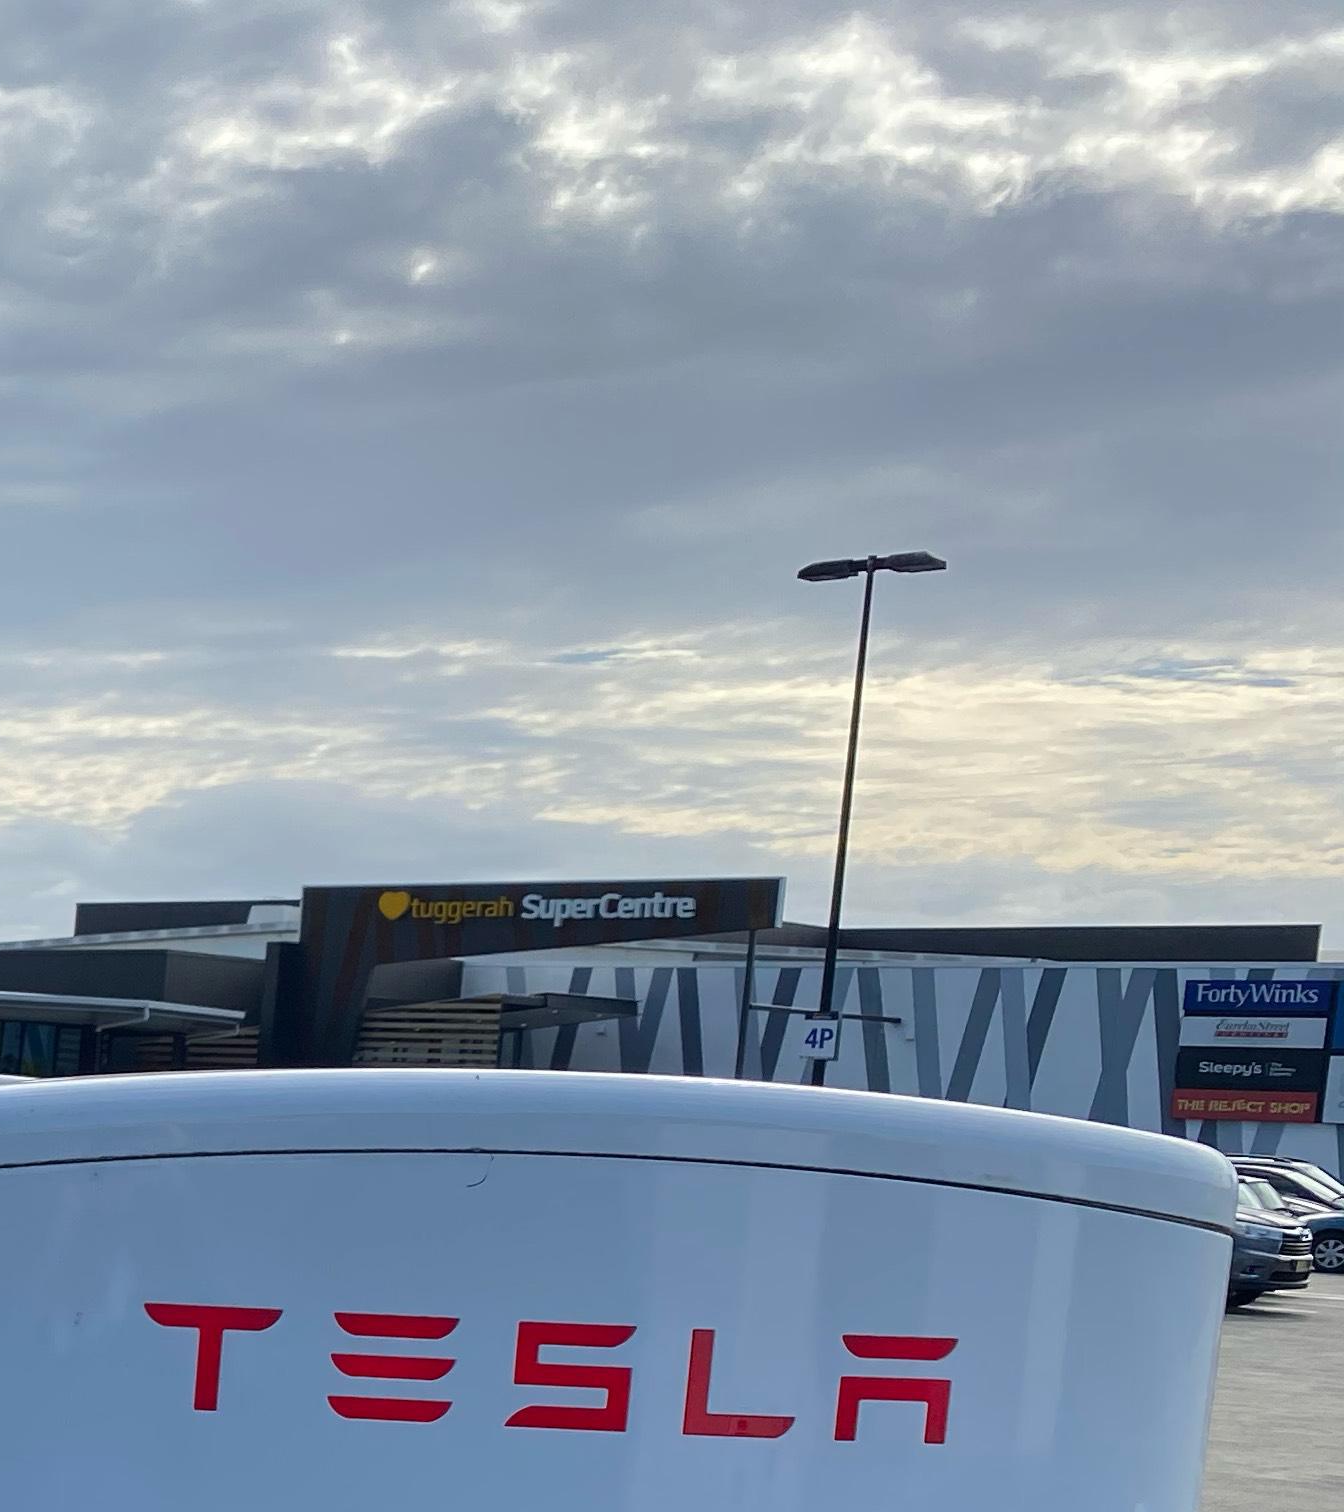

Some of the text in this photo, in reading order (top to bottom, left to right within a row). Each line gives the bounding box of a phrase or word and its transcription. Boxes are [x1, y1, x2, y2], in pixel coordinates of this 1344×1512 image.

[411, 892, 697, 927] tuggerah SuperCentre
[804, 1028, 834, 1049] 4P
[1198, 1061, 1262, 1077] Sleepy's
[1177, 1099, 1311, 1114] THE REJECT SHOP
[143, 1302, 959, 1445] TESLA
